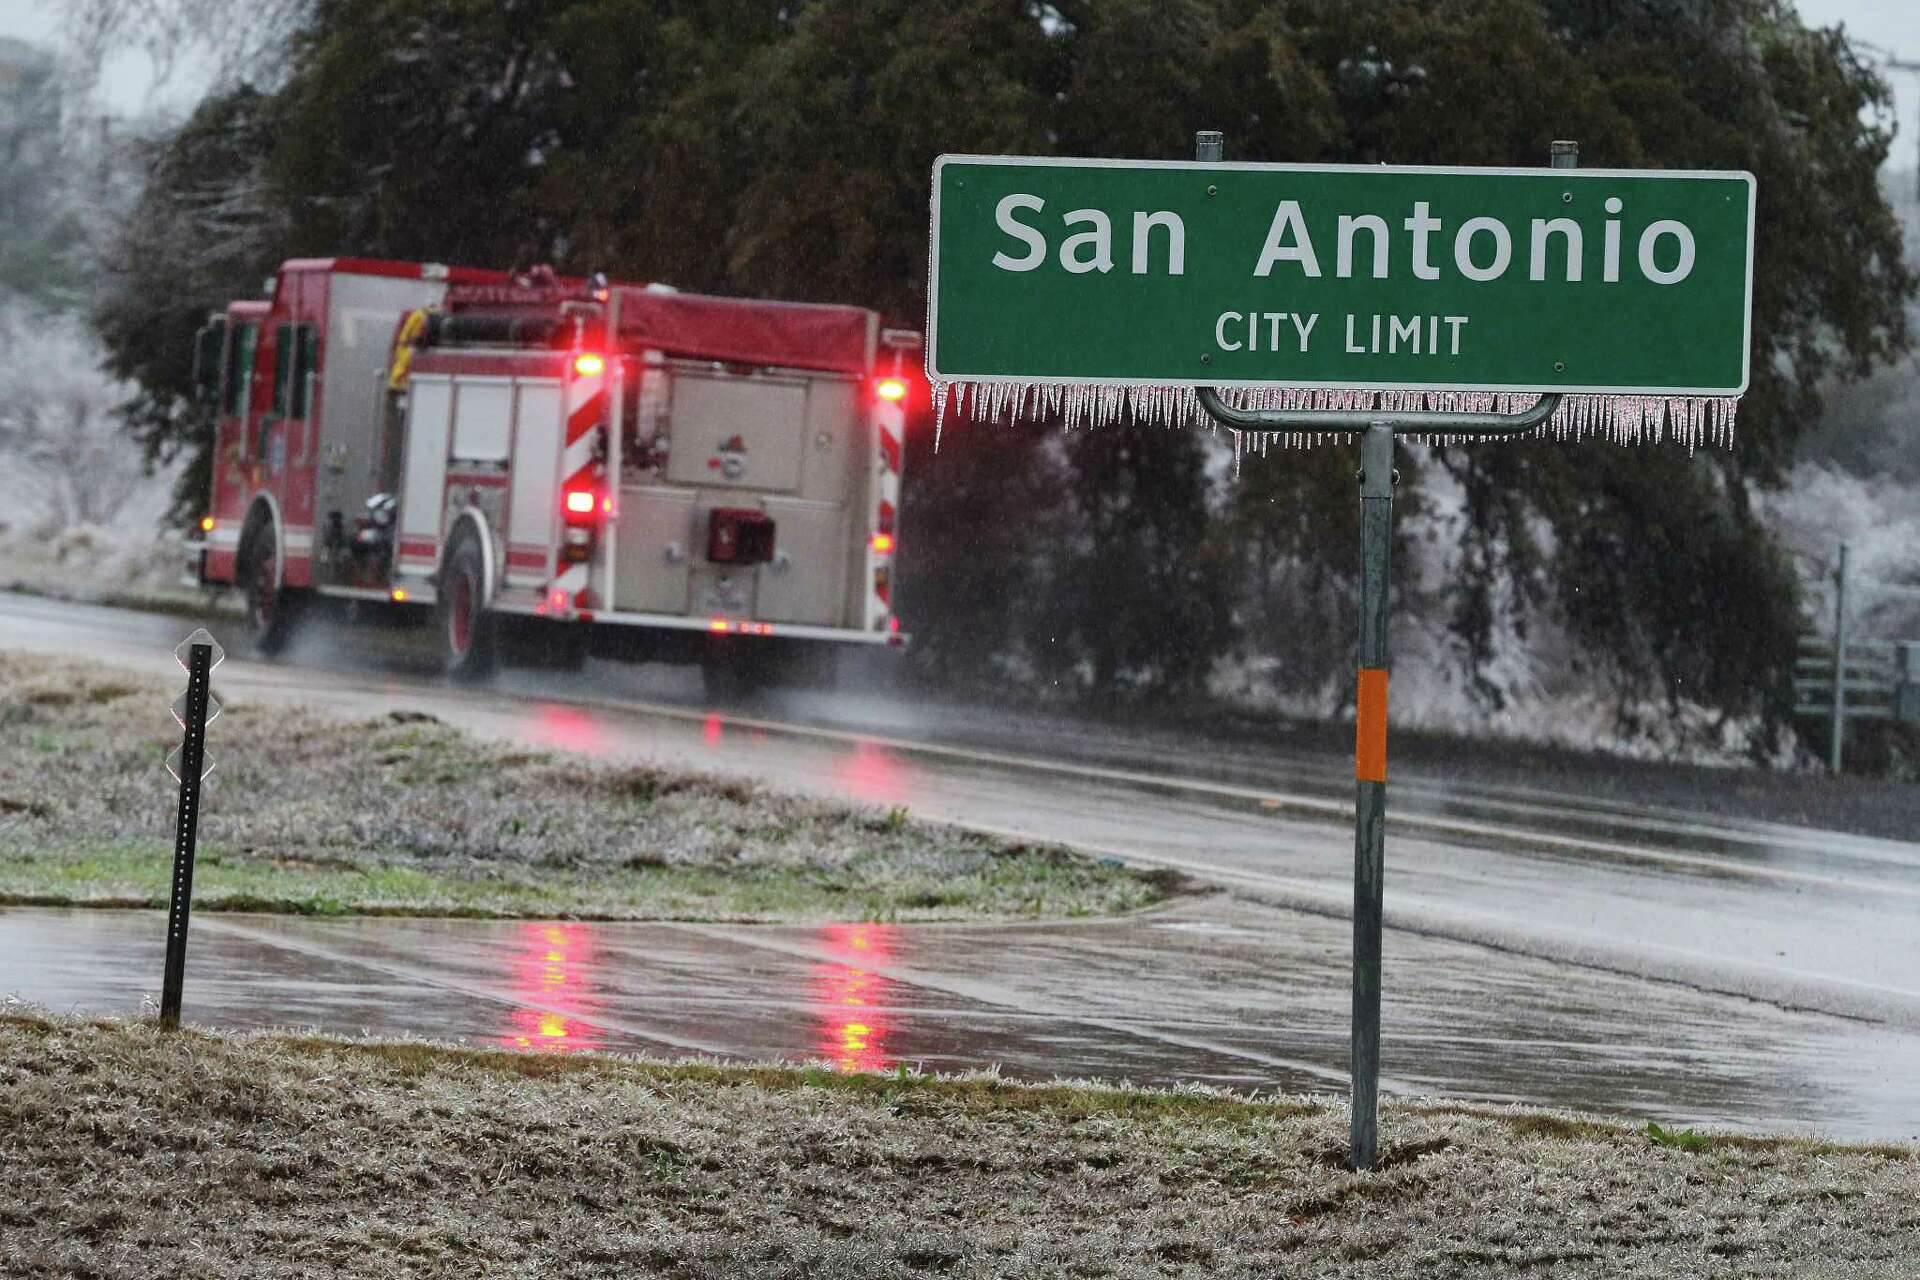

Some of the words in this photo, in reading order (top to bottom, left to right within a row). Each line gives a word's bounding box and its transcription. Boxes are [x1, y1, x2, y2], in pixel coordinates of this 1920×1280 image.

[991, 193, 1186, 276] San
[1252, 197, 1697, 286] Antonio
[1215, 311, 1320, 353] CITY
[1345, 314, 1469, 356] LIMIT
